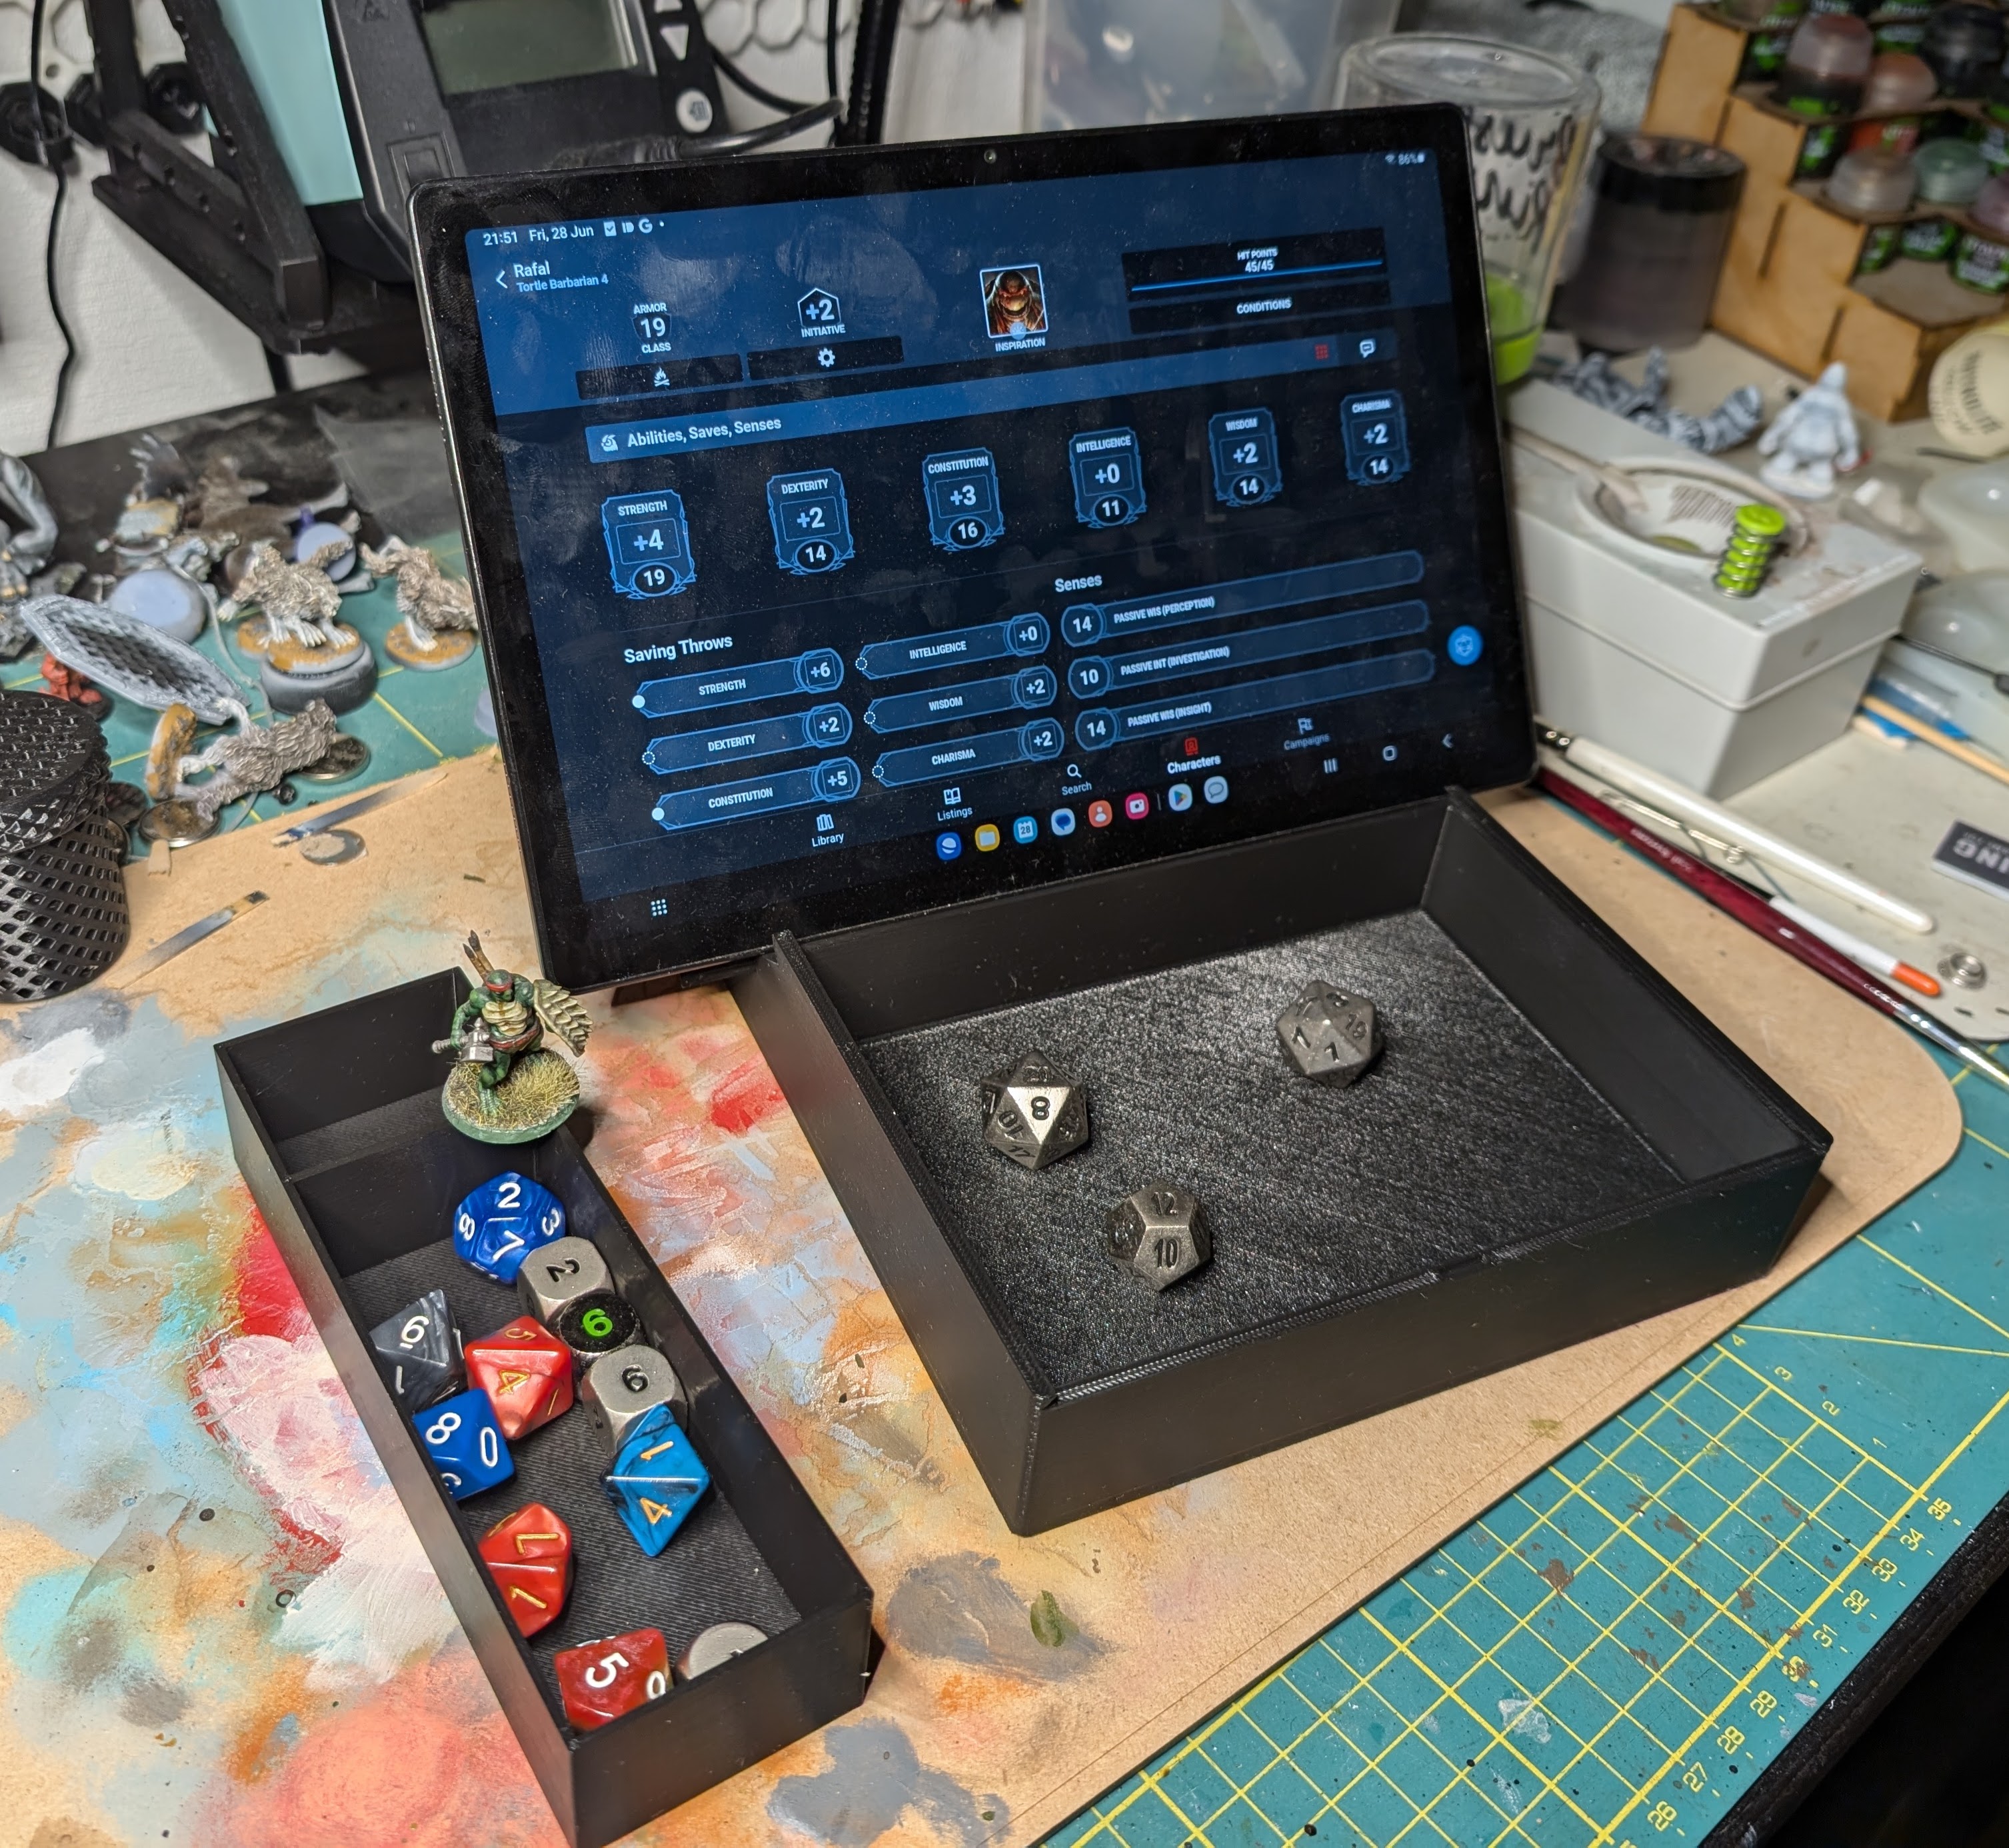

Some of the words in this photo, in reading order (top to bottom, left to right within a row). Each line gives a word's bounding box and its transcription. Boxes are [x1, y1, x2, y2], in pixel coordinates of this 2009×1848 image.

[483, 231, 518, 246] 21:51
[529, 228, 549, 242] Fri,
[551, 227, 568, 240] 28
[571, 225, 595, 239] Jun
[1237, 249, 1250, 261] HIT
[1251, 246, 1278, 259] POINTS
[513, 260, 551, 278] Rafal
[1244, 259, 1274, 273] 45/45
[516, 277, 548, 292] Tortle
[549, 275, 599, 290] Barbarian
[601, 273, 609, 285] 4
[633, 303, 667, 314] ARMOR
[805, 299, 835, 321] +2
[1236, 298, 1292, 314] CONDITIONS
[640, 317, 666, 338] 19
[801, 324, 846, 338] INITIATIVE
[641, 343, 671, 353] CLASS
[995, 337, 1046, 353] INSPIRATION
[1352, 399, 1392, 413] CHARISMA
[627, 428, 687, 448] Abilities,
[689, 423, 733, 441] Saves,
[734, 418, 782, 434] Senses
[1225, 417, 1258, 431] WISDOM
[1363, 423, 1389, 445] +2
[1076, 435, 1131, 453] INTELLIGENCE
[1233, 442, 1258, 464] +2
[928, 456, 989, 474] CONSTITUTION
[1094, 463, 1120, 484] +0
[1370, 457, 1389, 475] 14
[781, 479, 829, 495] DEXTERITY
[950, 485, 977, 505] +3
[1239, 477, 1259, 495] 14
[618, 501, 667, 517] STRENGTH
[1102, 499, 1120, 517] 11
[797, 507, 826, 529] +2
[958, 523, 979, 539] 16
[633, 529, 664, 552] +4
[805, 545, 827, 563] 14
[643, 568, 666, 587] 19
[1054, 575, 1103, 593] Senses
[1113, 607, 1146, 623] PASSIVE
[1146, 605, 1162, 619] WIS
[1162, 596, 1215, 617] (PERCEPTION)
[1072, 615, 1092, 633] 14
[1018, 626, 1038, 641] +0
[624, 644, 677, 664] Saving
[678, 636, 734, 655] Throws
[909, 641, 967, 659] INTELLIGENCE
[1120, 659, 1153, 675] PASSIVE
[1153, 657, 1166, 671] INT
[1167, 645, 1230, 669] (INVESTIGATION)
[810, 661, 831, 678] +6
[1080, 669, 1099, 685] 10
[699, 679, 747, 696] STRENGTH
[1026, 679, 1046, 695] +2
[929, 696, 963, 711] WISDOM
[1127, 711, 1160, 727] PASSIVE
[1160, 709, 1174, 722] WIS
[1174, 701, 1212, 719] (INSIGHT)
[819, 717, 840, 733] +2
[1086, 720, 1106, 737] 14
[708, 734, 756, 752] DEXTERITY
[1033, 731, 1053, 747] +2
[1284, 733, 1331, 750] Campaigns
[931, 748, 976, 765] CHARISMA
[1166, 755, 1222, 774] Characters
[827, 770, 848, 787] +5
[708, 787, 773, 808] CONSTITUTION
[1061, 781, 1092, 796] Search
[937, 807, 973, 821] Listings
[1020, 825, 1031, 835] 28
[811, 833, 845, 847] Library
[1030, 1096, 1050, 1121] 8
[498, 1182, 521, 1209] 2
[1150, 1191, 1178, 1217] 12
[459, 1213, 475, 1241] 8
[541, 1207, 561, 1236] 3
[492, 1229, 525, 1261] 7
[1154, 1238, 1179, 1268] 10
[546, 1258, 581, 1283] 2
[582, 1307, 613, 1337] 6
[1732, 1333, 1747, 1347] 4
[497, 1370, 531, 1395] 4
[621, 1364, 649, 1392] 6
[1774, 1366, 1793, 1381] 3
[1822, 1400, 1840, 1416] 2
[425, 1412, 461, 1444] 8
[480, 1427, 498, 1467] 0
[641, 1441, 673, 1460] 1
[1872, 1437, 1888, 1449] 1
[639, 1497, 673, 1525] 4
[1927, 1497, 1952, 1521] 35
[1900, 1527, 1926, 1551] 34
[1842, 1589, 1870, 1615] 32
[1812, 1623, 1838, 1648] 31
[585, 1651, 629, 1689] 5
[1750, 1690, 1777, 1718] 29
[1716, 1725, 1745, 1755] 28
[1682, 1761, 1708, 1793] 27
[1647, 1801, 1677, 1832] 26
